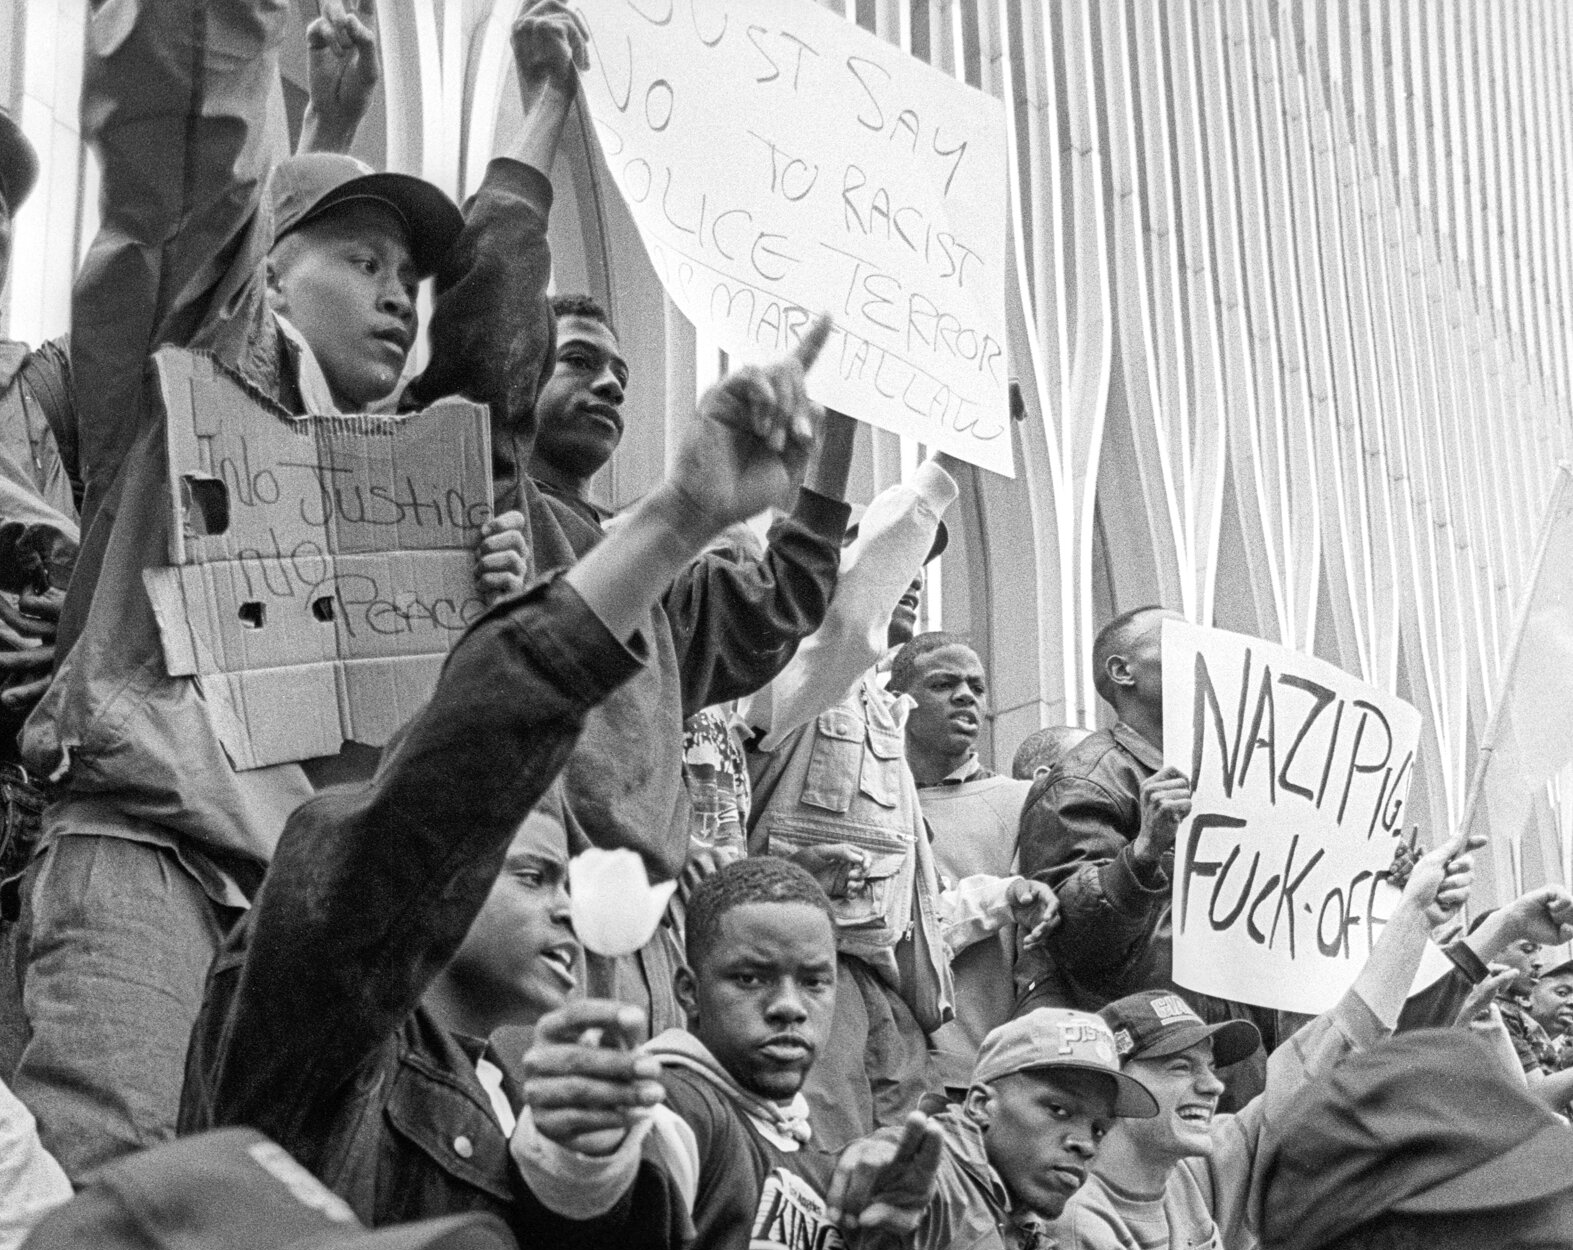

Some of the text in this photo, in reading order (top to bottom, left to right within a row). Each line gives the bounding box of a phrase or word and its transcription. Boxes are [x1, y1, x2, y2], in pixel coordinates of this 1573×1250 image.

[846, 56, 967, 196] SAY
[746, 130, 819, 202] TO
[841, 164, 985, 288] RACIST
[819, 241, 1003, 389] TERROR
